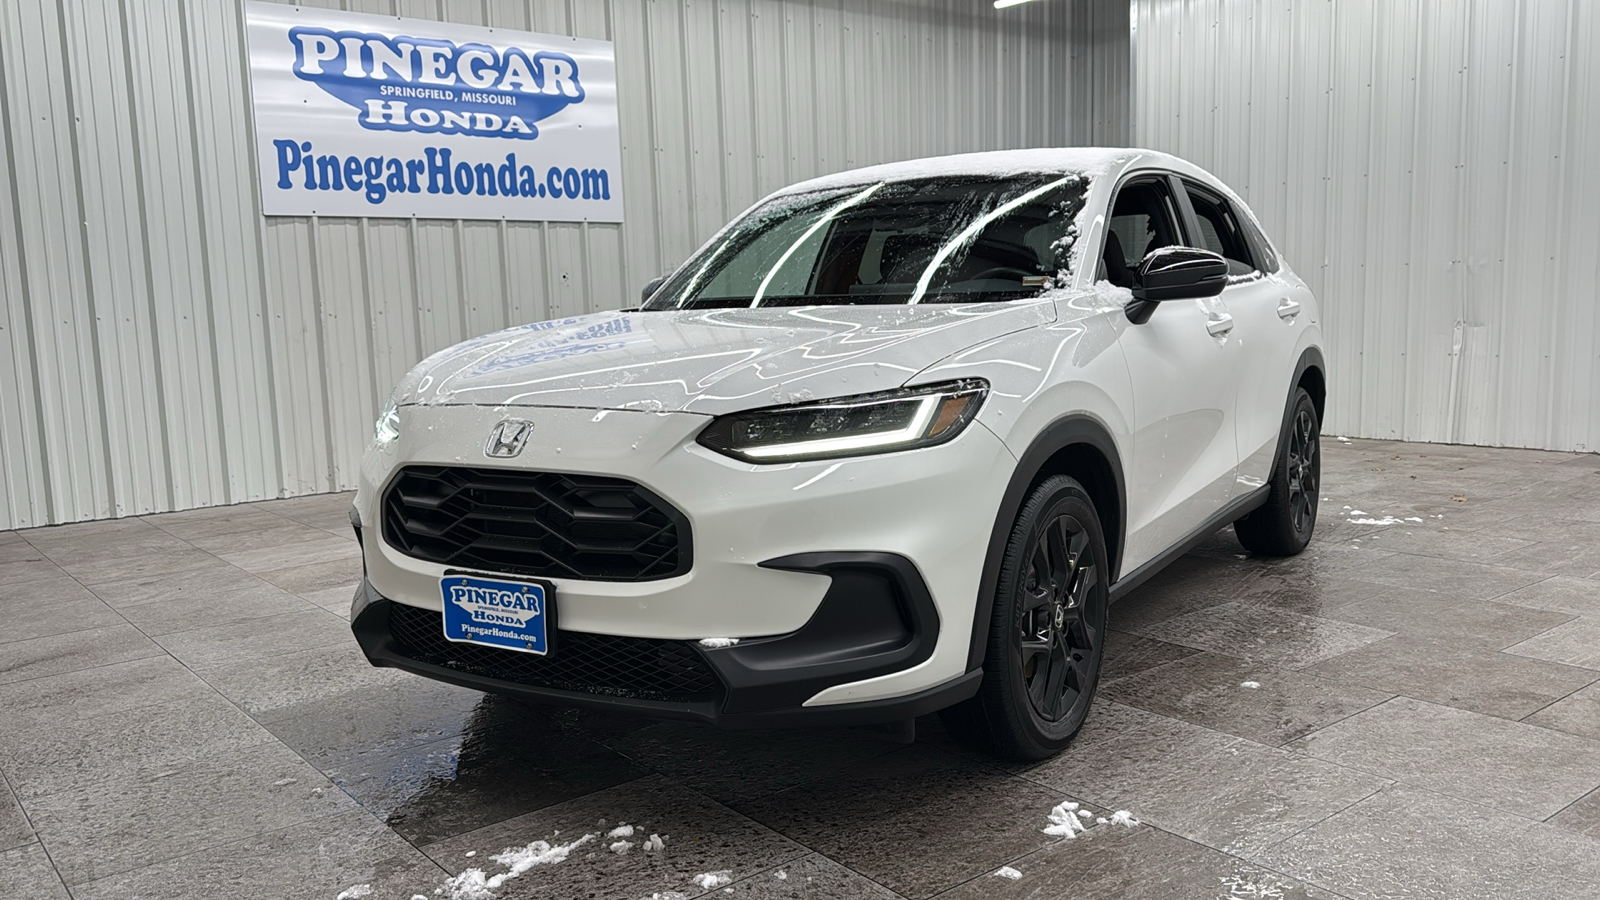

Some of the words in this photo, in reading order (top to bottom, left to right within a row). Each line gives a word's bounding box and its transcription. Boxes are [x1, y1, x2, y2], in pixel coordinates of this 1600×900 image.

[296, 33, 580, 97] PINEGAR
[380, 85, 458, 102] SPRINGFIELD,
[462, 92, 516, 106] MISSOURI
[364, 99, 533, 134] HONDA
[272, 138, 611, 204] PinegarHonda.com
[453, 588, 538, 612] PINEGAR
[473, 611, 524, 625] HONDA
[461, 624, 537, 642] PinegarHonda.com
